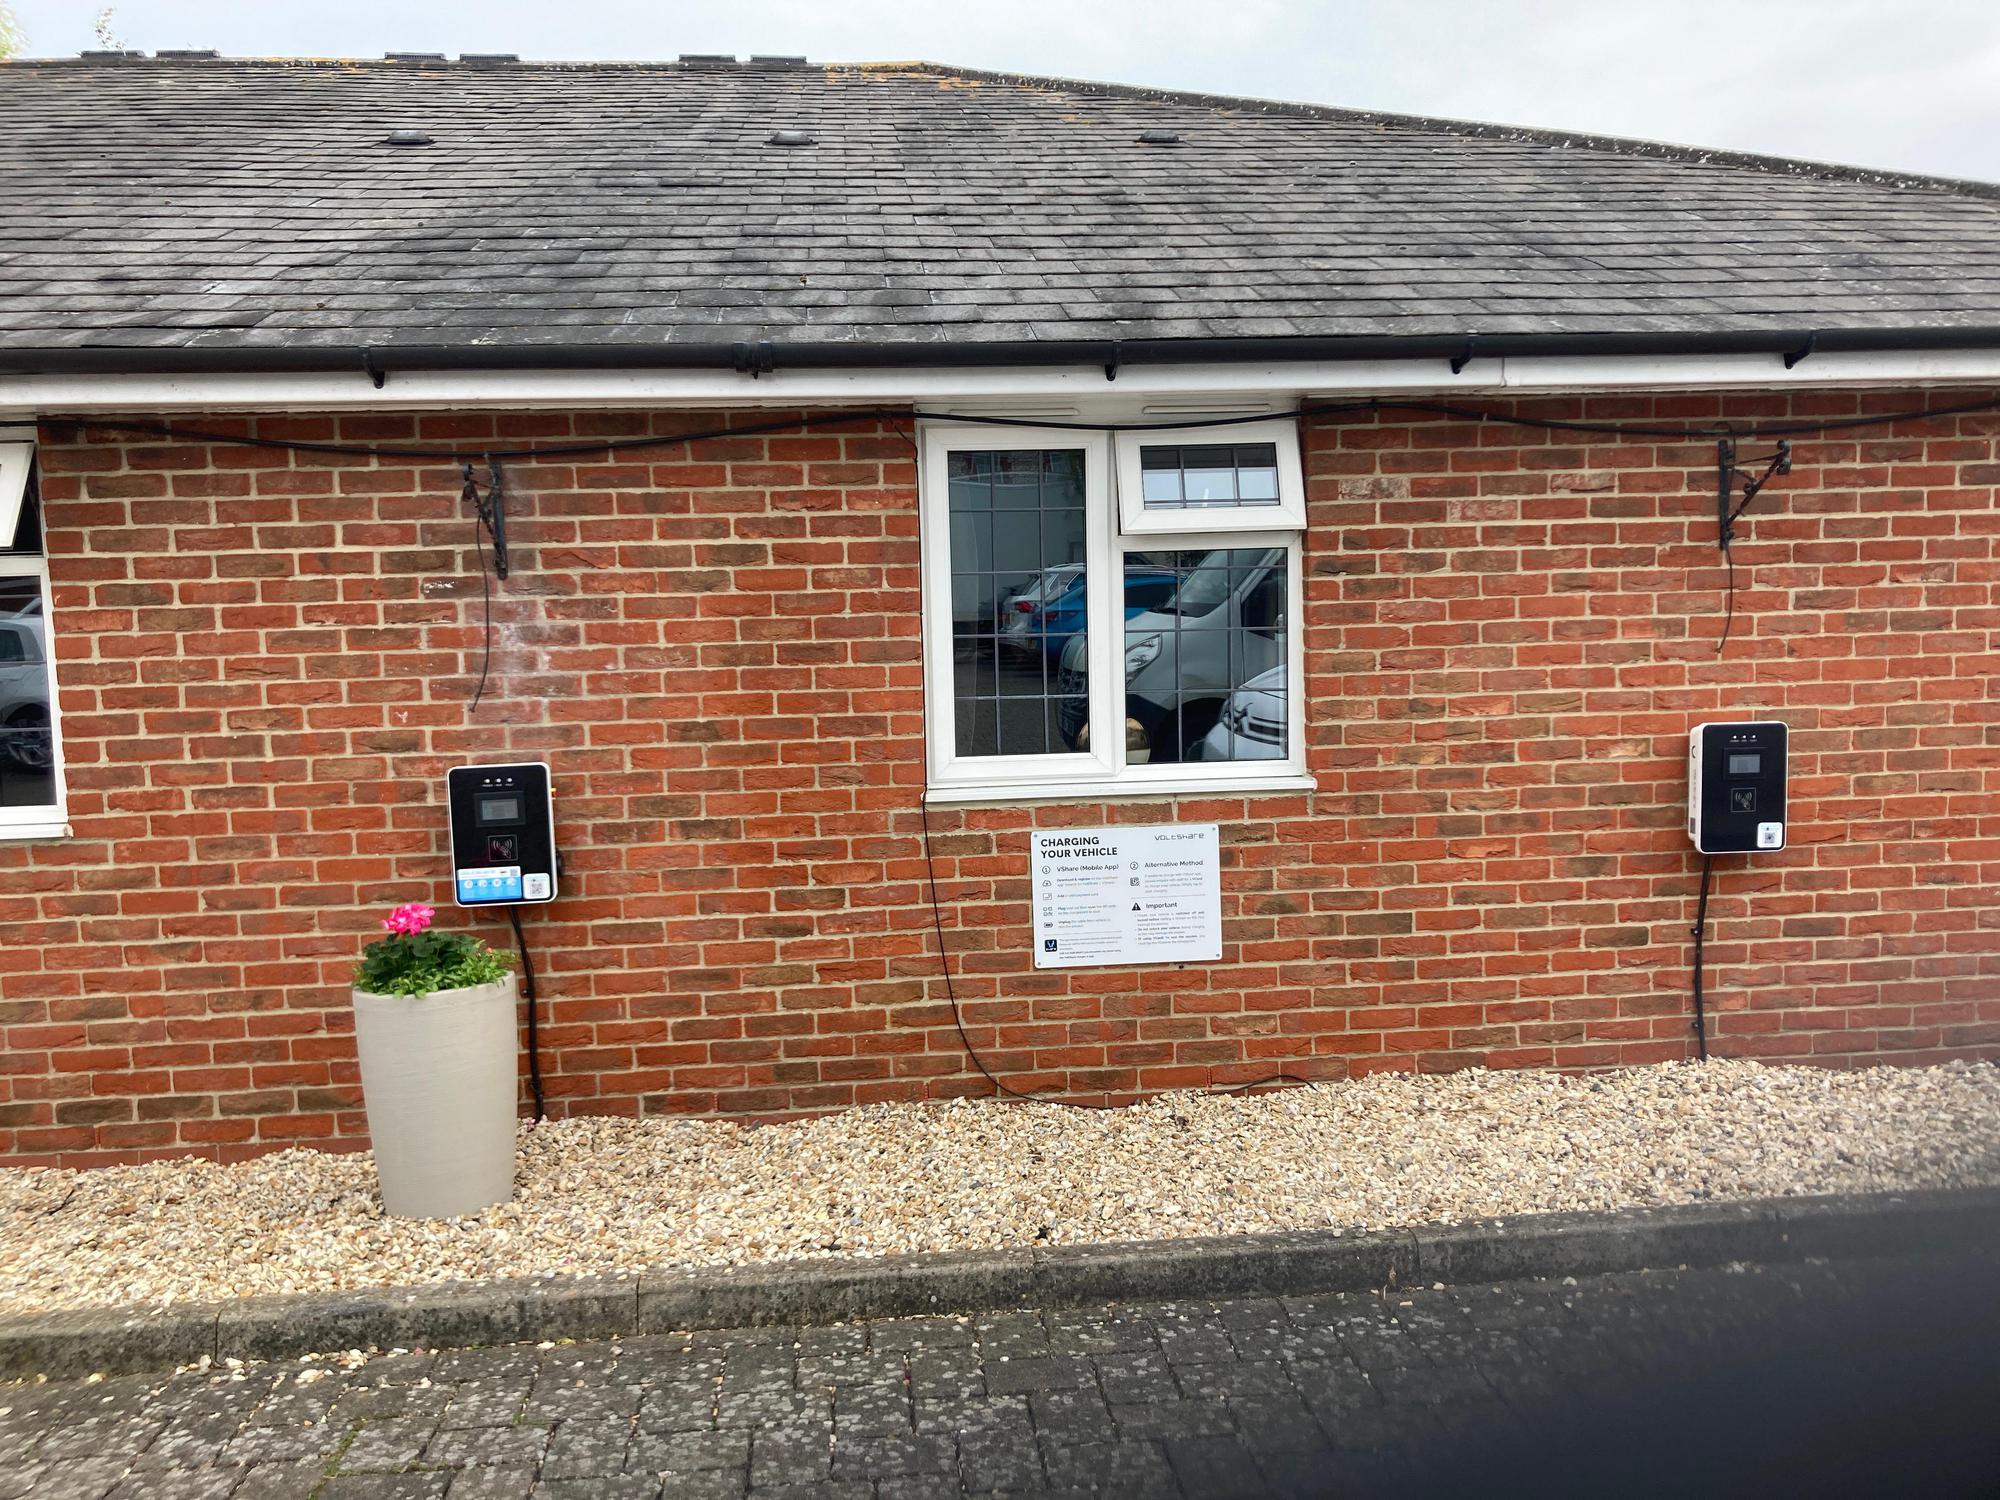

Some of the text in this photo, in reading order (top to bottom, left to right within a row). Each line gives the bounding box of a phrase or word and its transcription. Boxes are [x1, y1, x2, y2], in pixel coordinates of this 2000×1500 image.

[1040, 836, 1100, 847] CHARGING
[1040, 847, 1118, 859] YOUR VEHICLE
[1080, 864, 1104, 872] (Mobile
[1104, 863, 1120, 871] App)
[1145, 902, 1178, 910] Important
